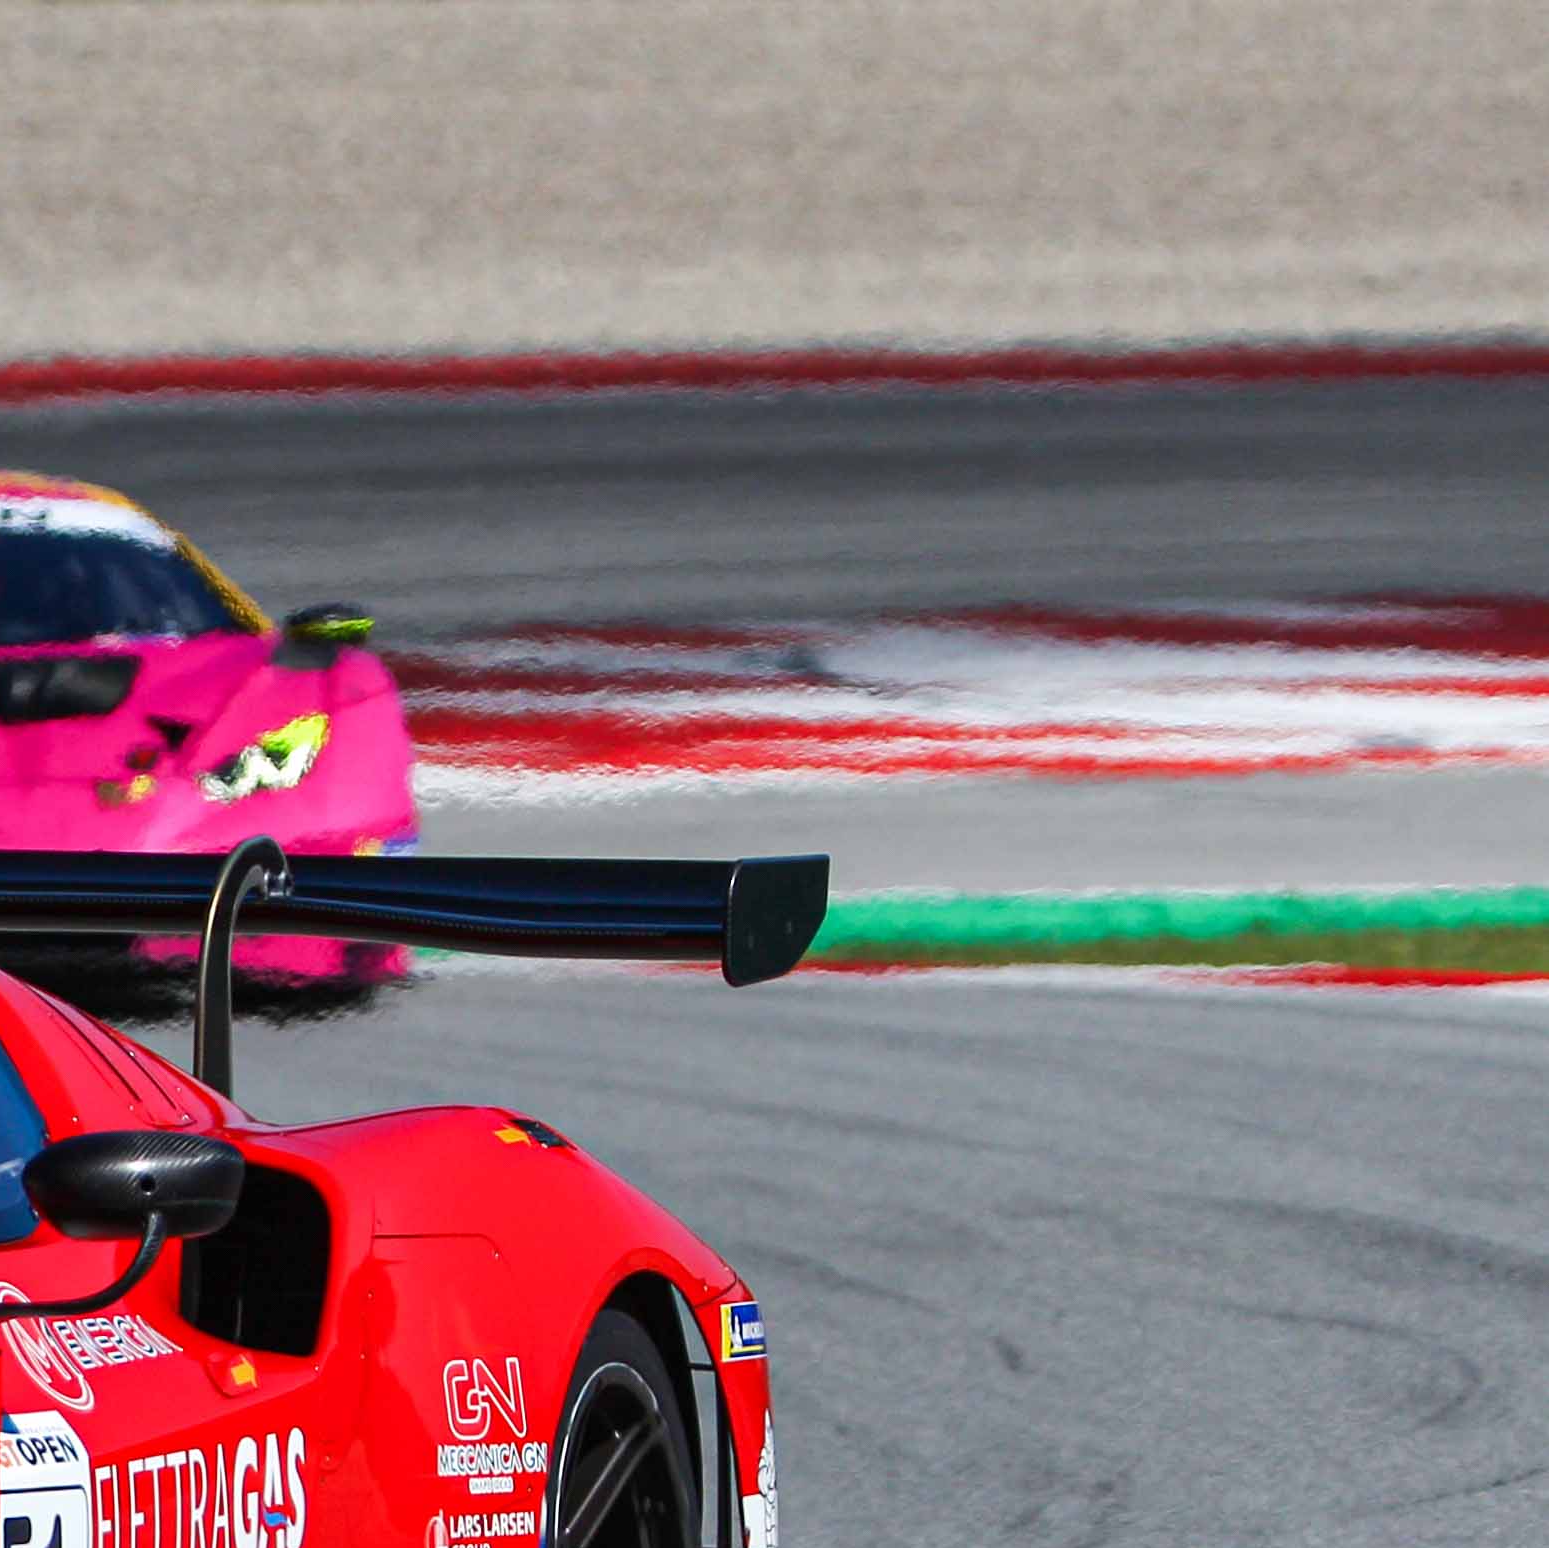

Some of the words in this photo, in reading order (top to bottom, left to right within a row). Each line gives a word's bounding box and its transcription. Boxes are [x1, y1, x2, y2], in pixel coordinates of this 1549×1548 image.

[437, 1443, 522, 1477] MECCANICA
[521, 1441, 548, 1474] GN
[449, 1513, 482, 1538] LARS
[483, 1511, 535, 1537] LARSEN
